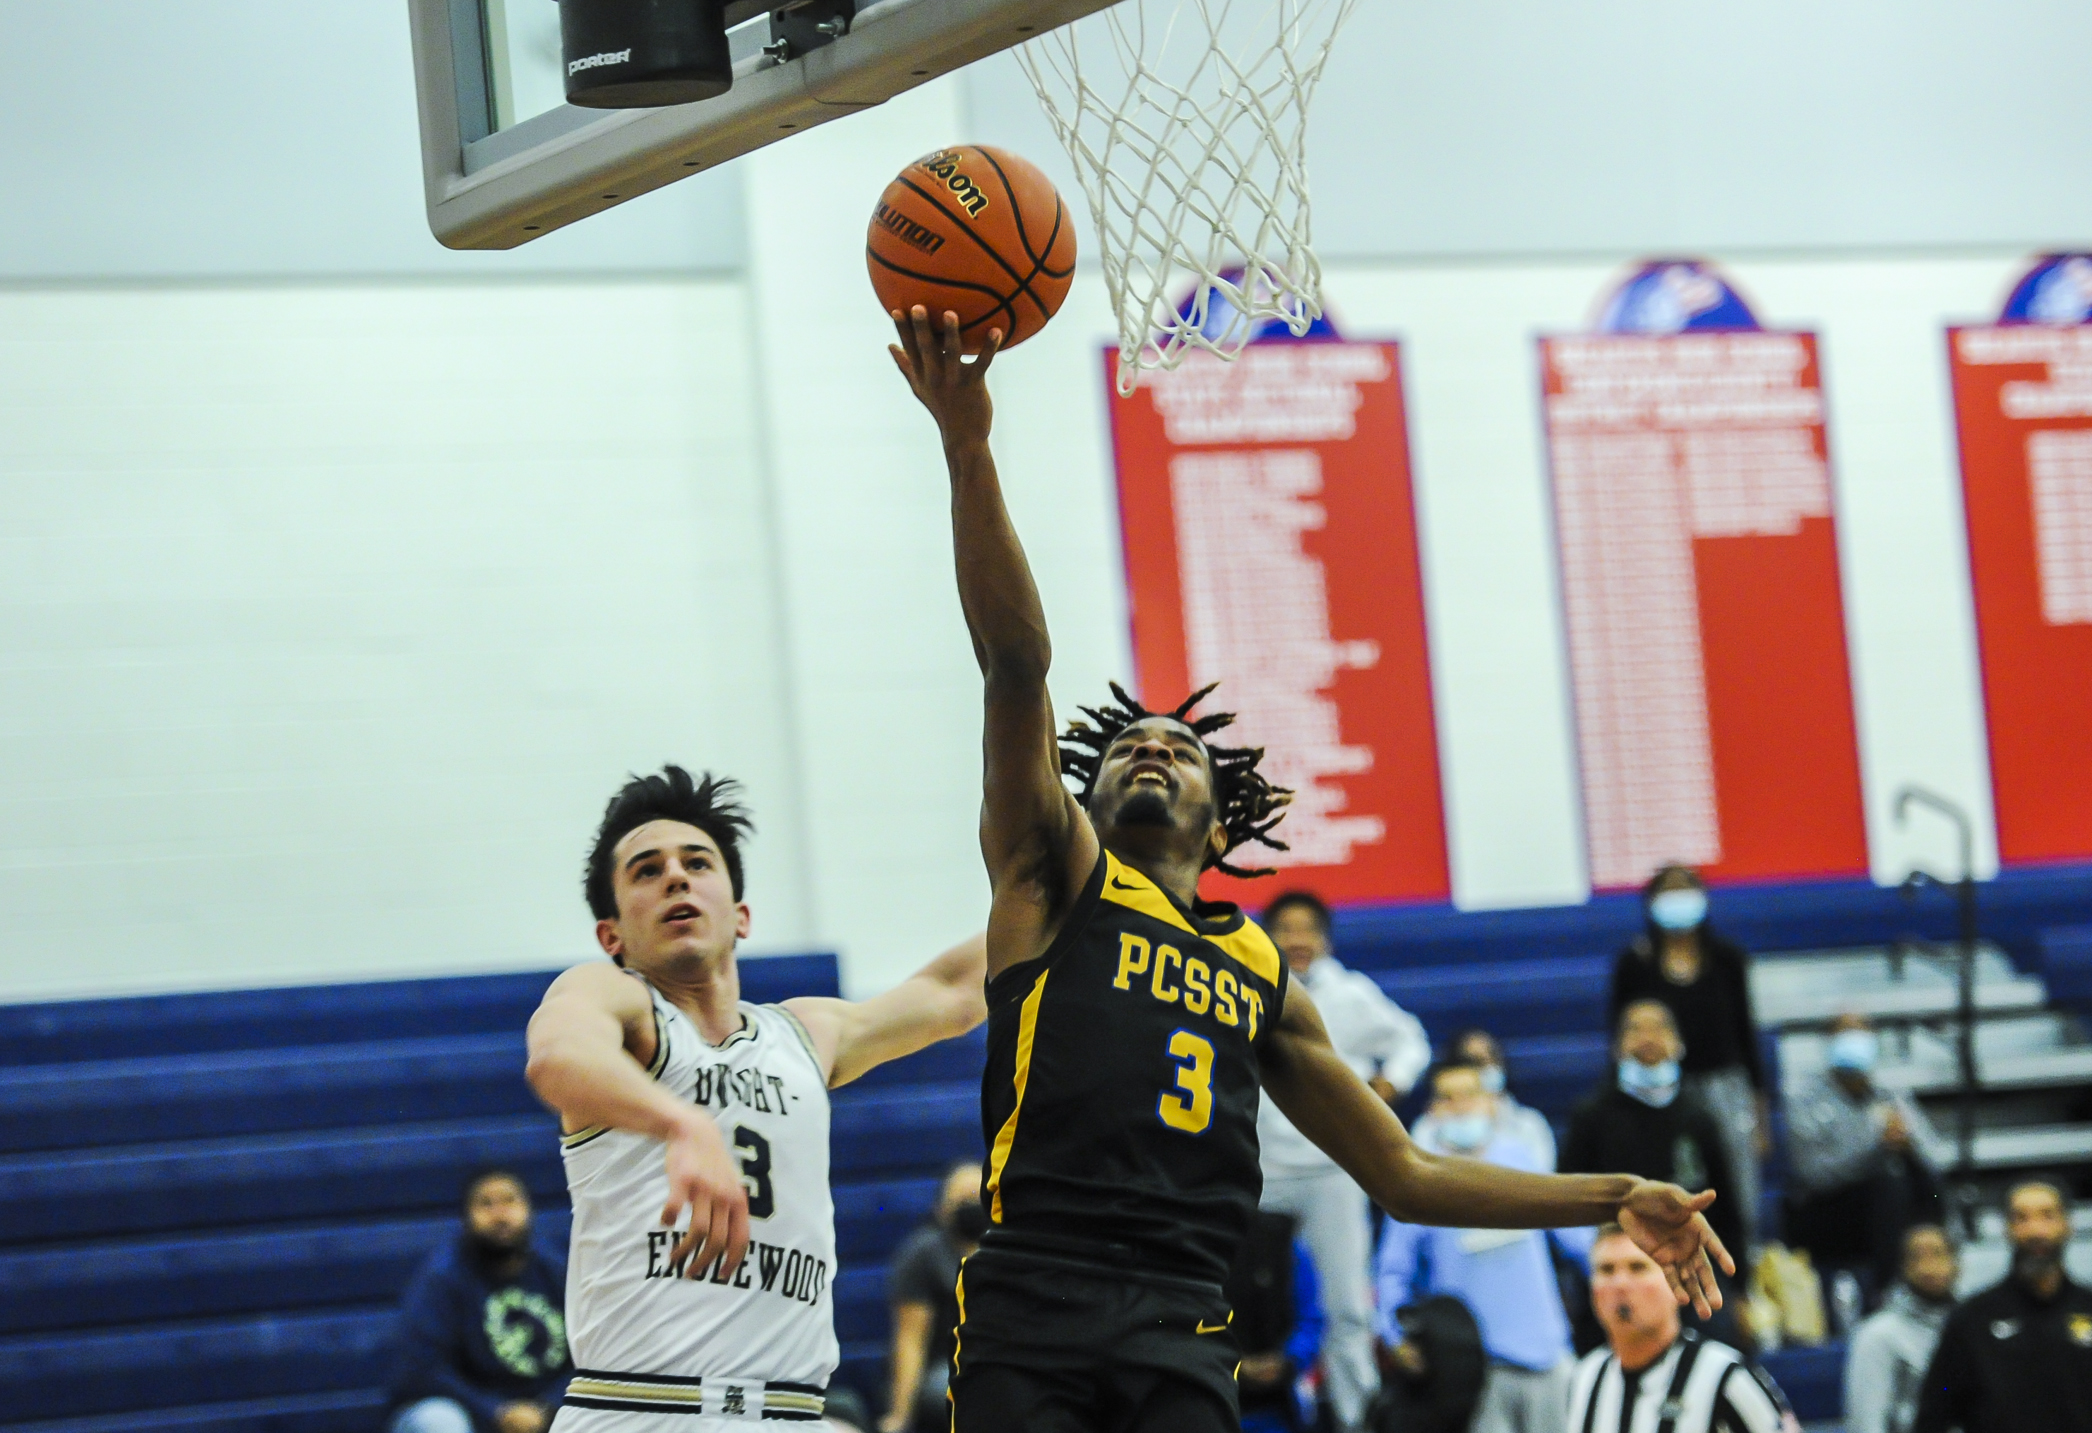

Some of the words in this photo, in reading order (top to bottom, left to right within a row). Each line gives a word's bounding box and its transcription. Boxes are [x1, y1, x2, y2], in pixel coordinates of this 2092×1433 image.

[1113, 931, 1264, 1042] PCSST
[1156, 1027, 1217, 1136] 3
[645, 1230, 827, 1306] ENLEWOOD
